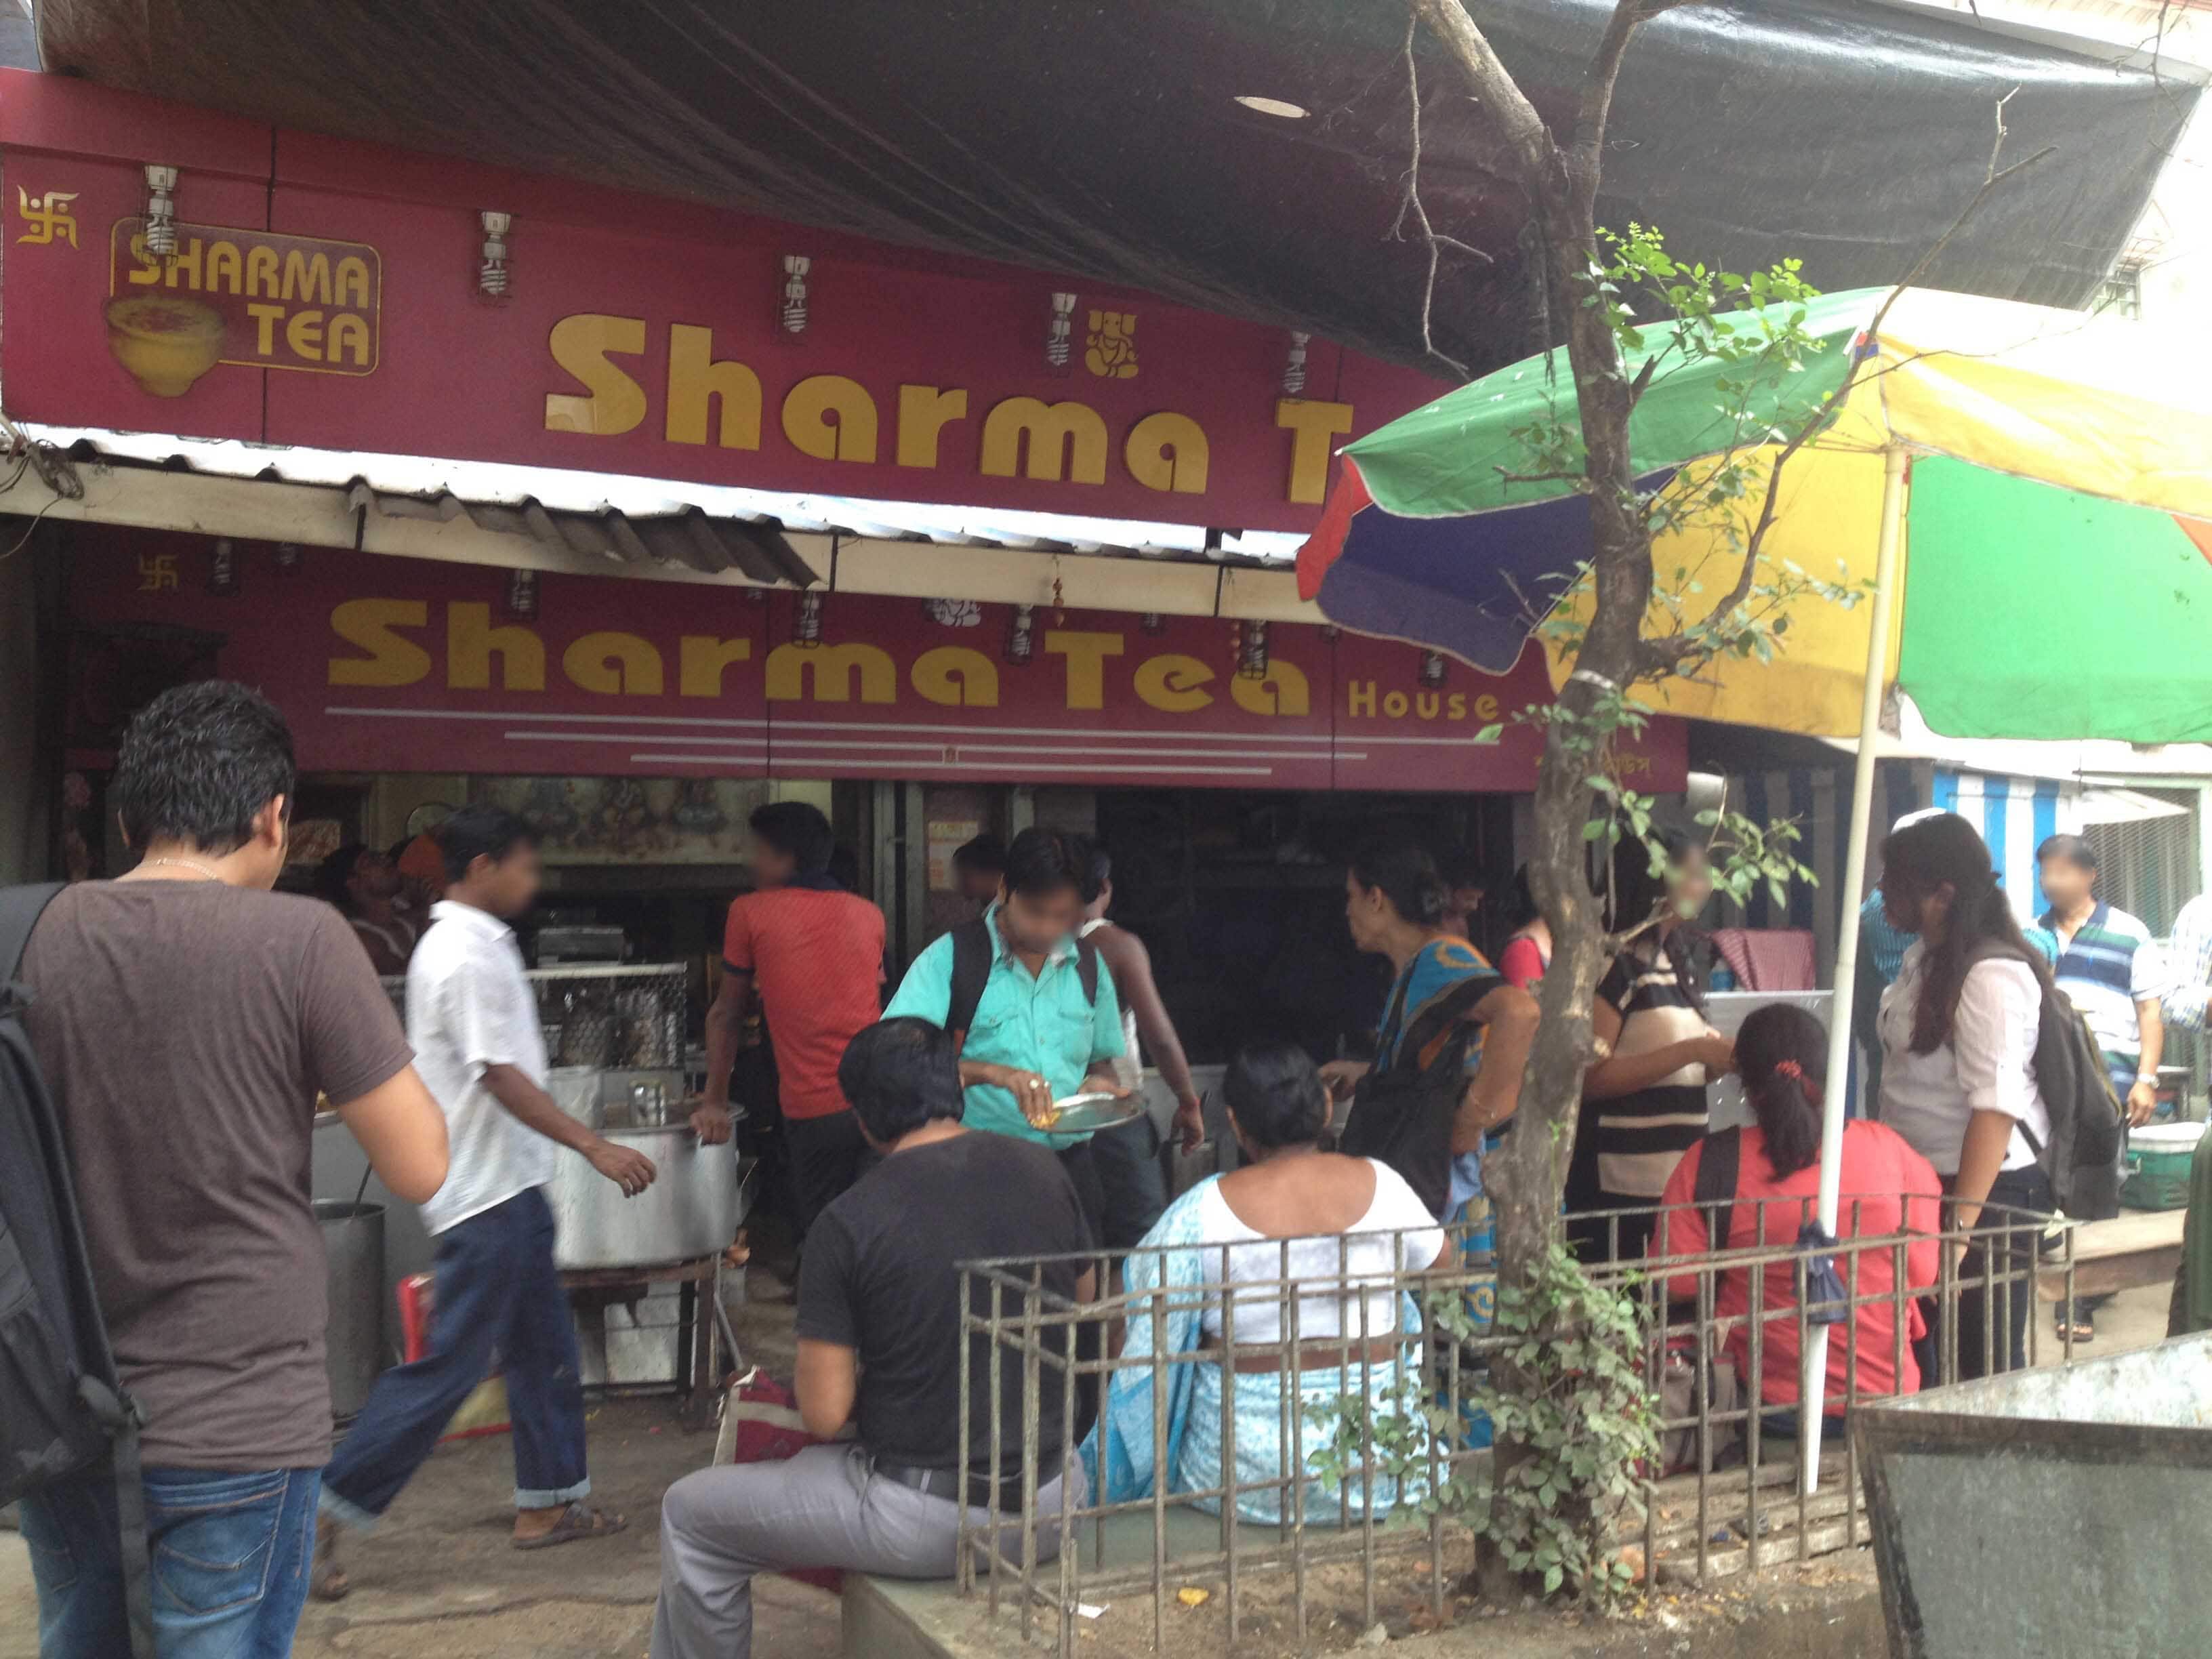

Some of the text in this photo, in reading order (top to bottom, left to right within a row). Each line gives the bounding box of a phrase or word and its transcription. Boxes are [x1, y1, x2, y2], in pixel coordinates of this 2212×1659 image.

[128, 234, 369, 309] SHARMA
[247, 302, 369, 366] TEA
[545, 313, 1354, 504] Sharma T
[328, 598, 1500, 721] Sharma Tea House
